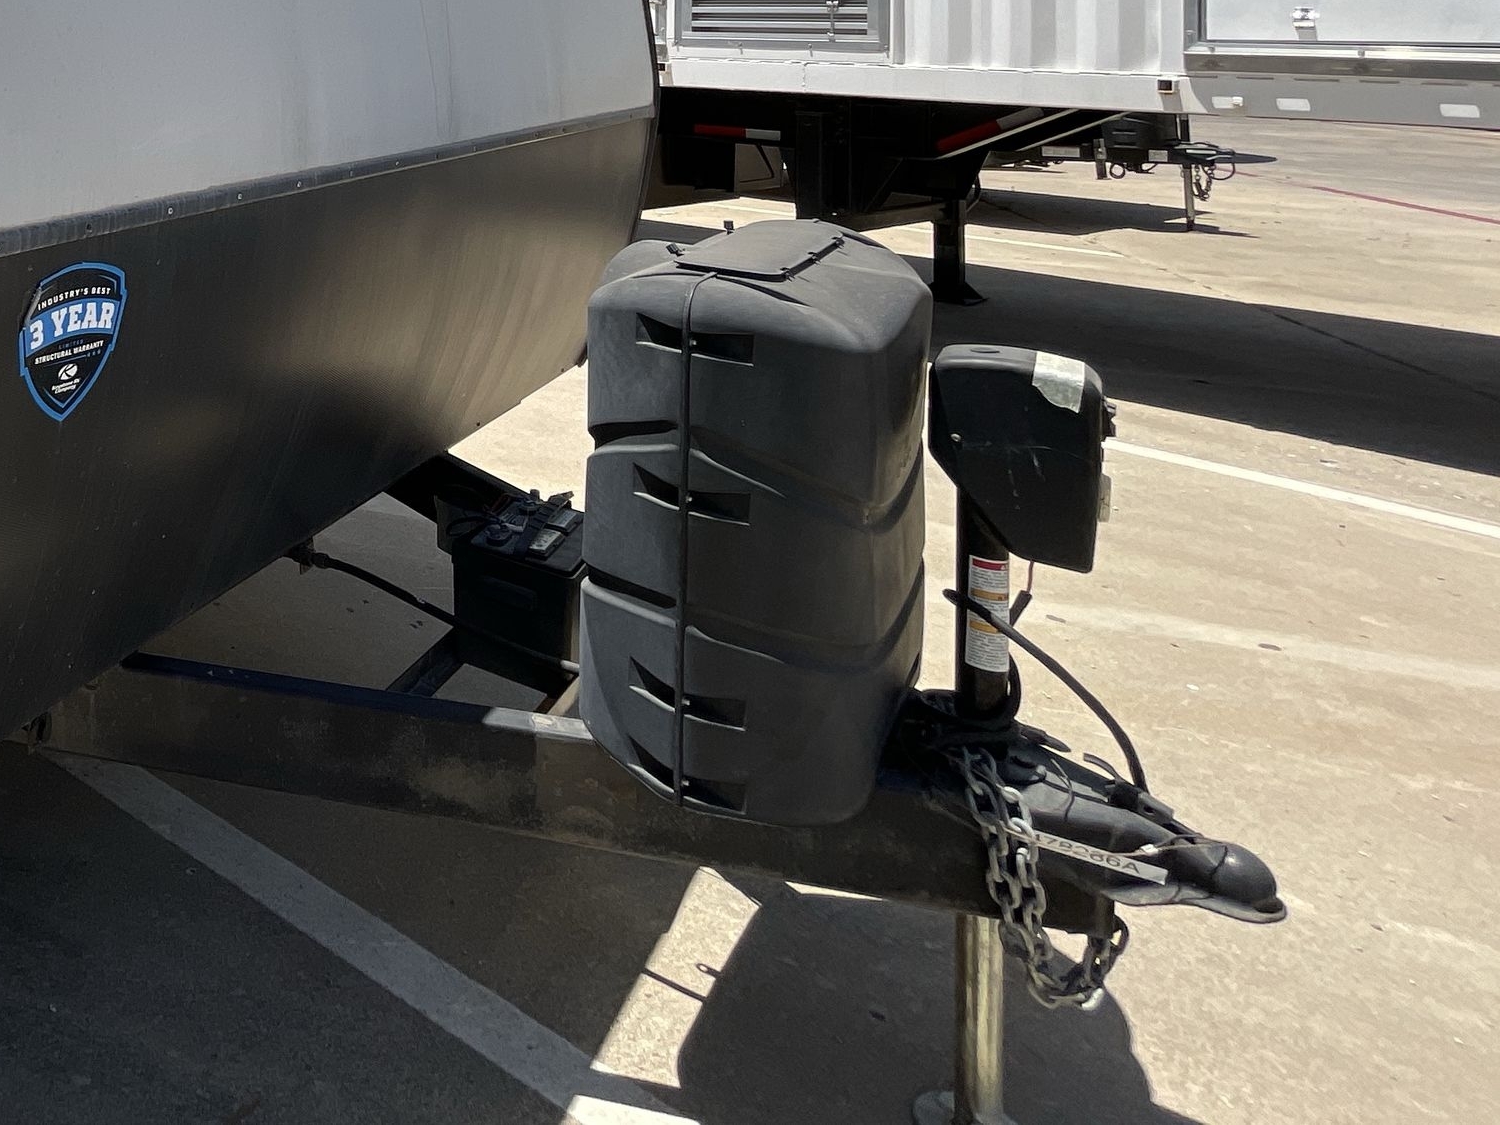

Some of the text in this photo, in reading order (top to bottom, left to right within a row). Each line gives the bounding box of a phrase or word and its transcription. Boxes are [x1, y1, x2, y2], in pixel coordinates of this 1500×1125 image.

[37, 286, 111, 311] INDUSTRY'S BEST
[29, 302, 115, 350] 3 YEAR
[34, 340, 104, 364] STRUCTURAL WARRANTY
